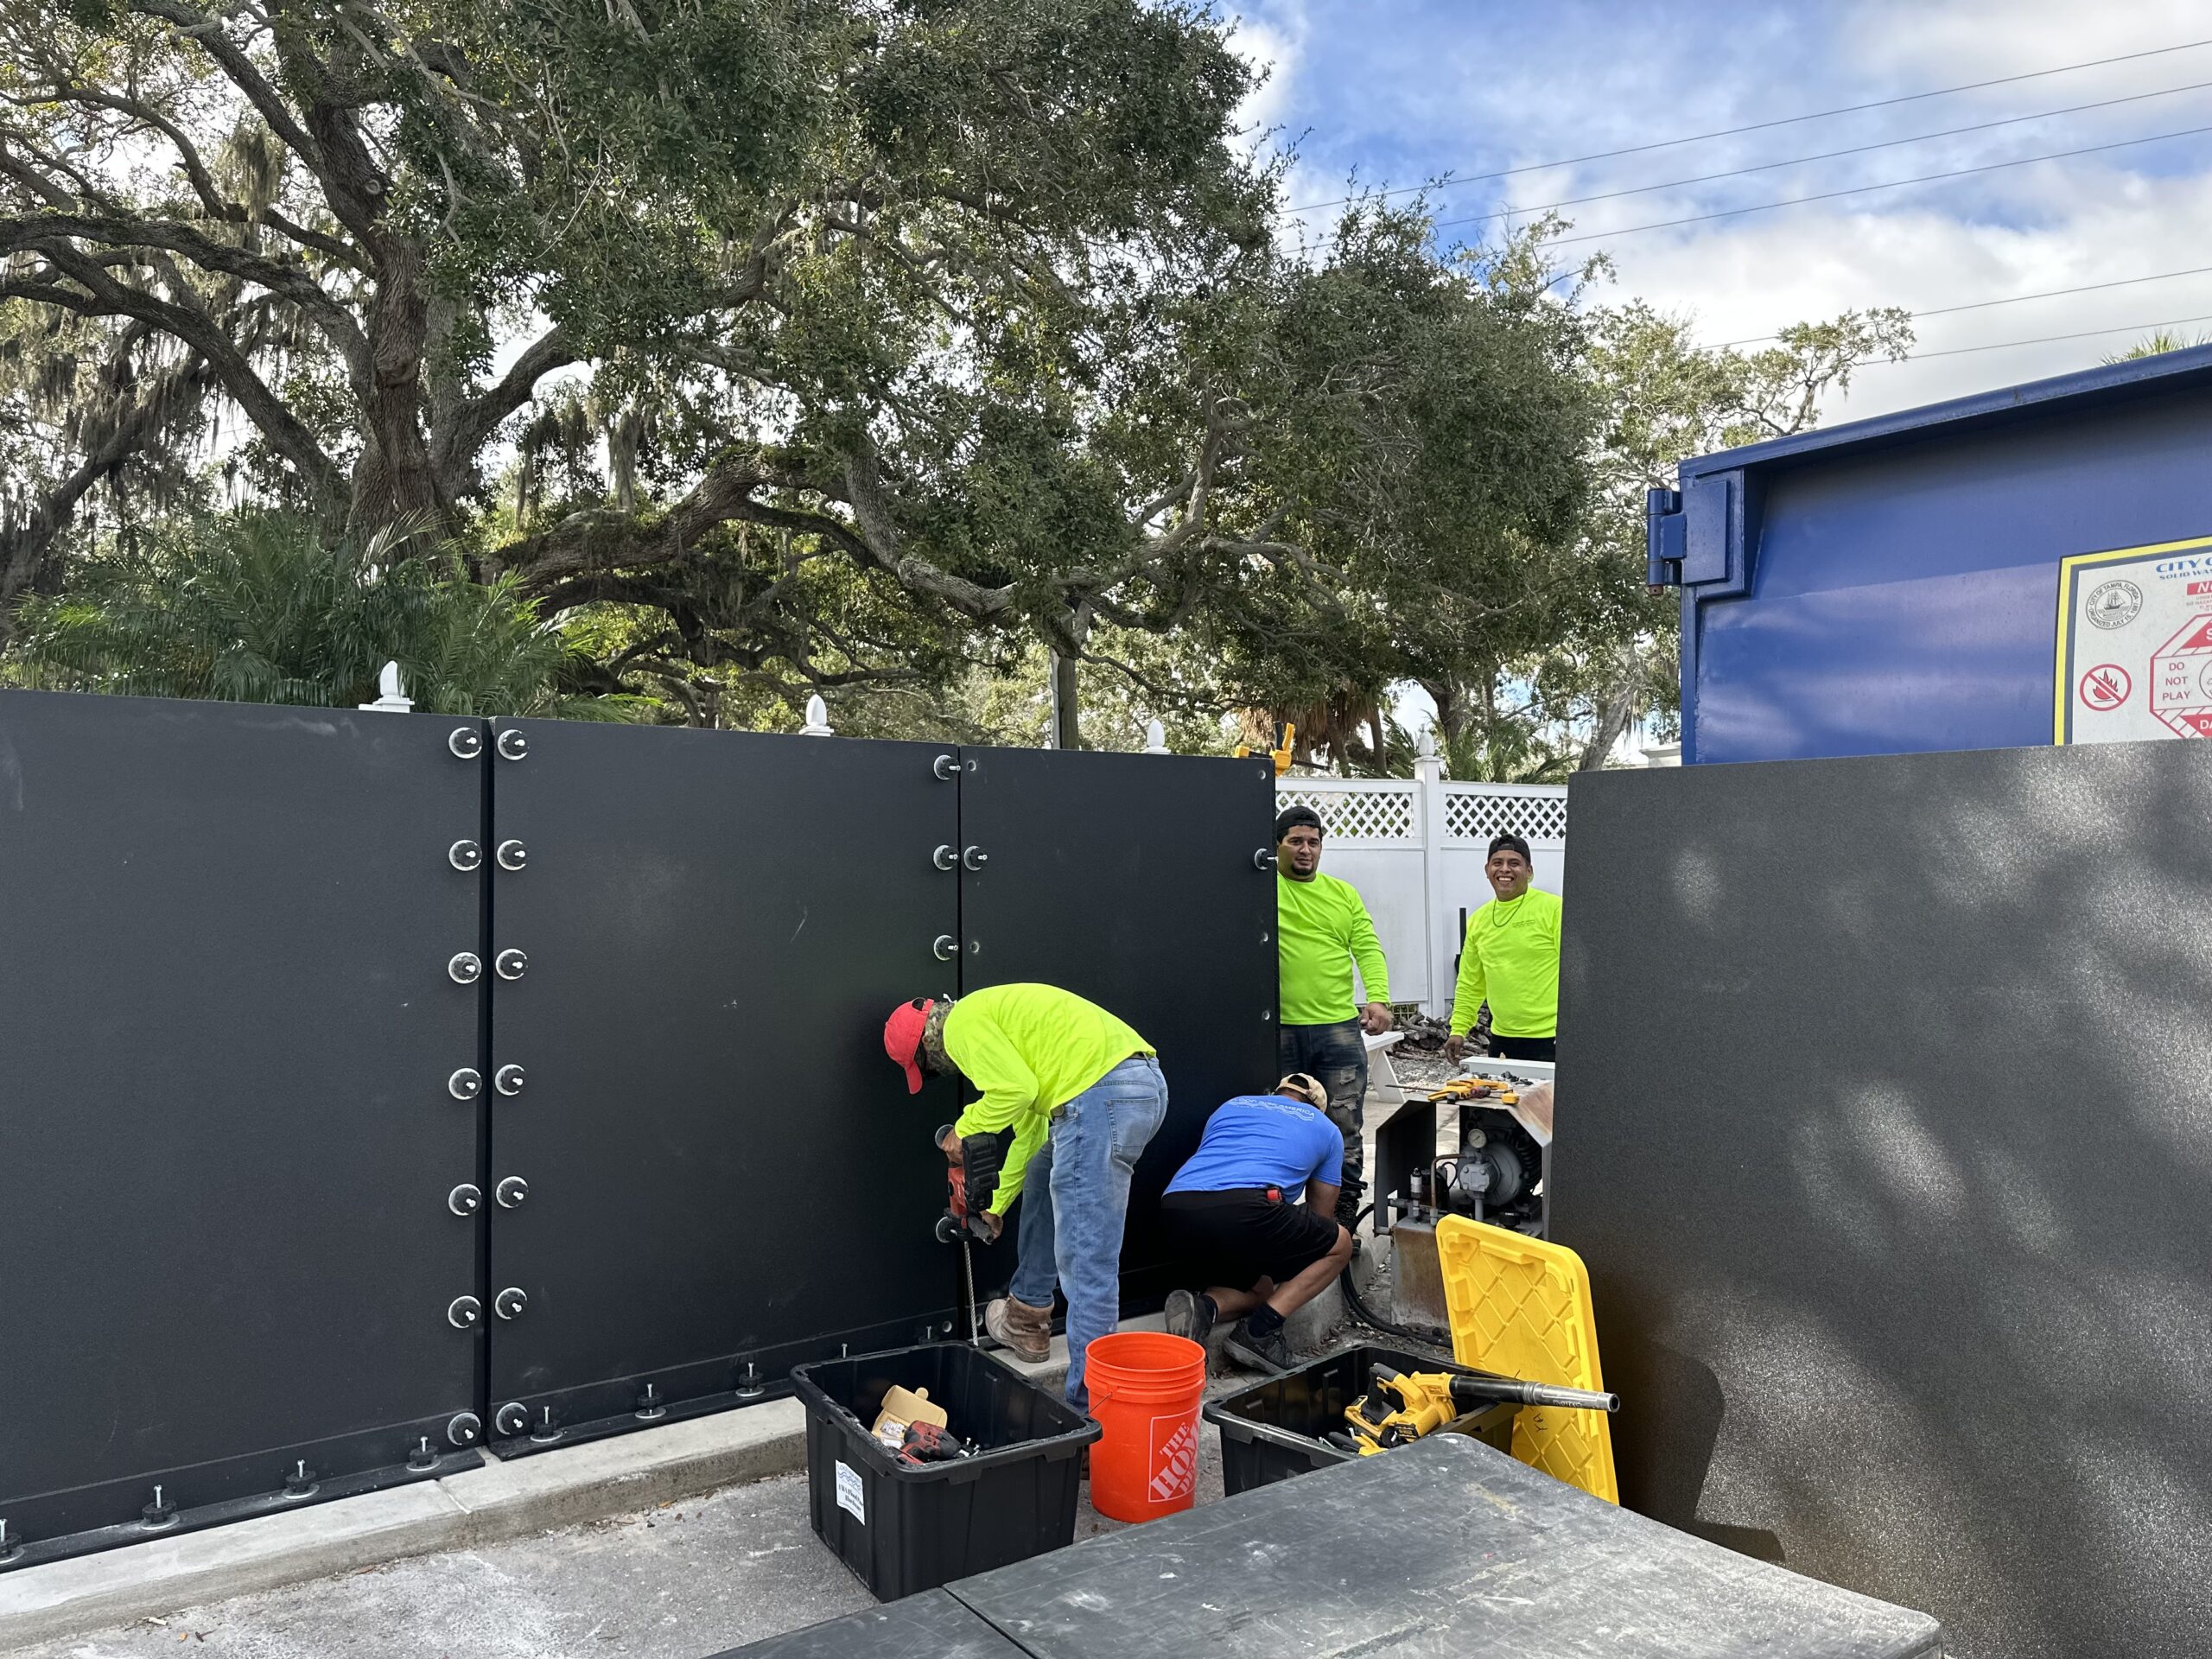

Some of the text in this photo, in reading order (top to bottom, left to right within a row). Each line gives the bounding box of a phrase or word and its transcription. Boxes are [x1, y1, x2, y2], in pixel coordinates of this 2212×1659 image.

[2156, 558, 2201, 573] CITY
[2124, 583, 2139, 600] FLORIDA
[2196, 582, 2212, 593] N
[2088, 608, 2111, 627] ORGANIZED
[2111, 619, 2125, 627] JULY
[2169, 661, 2184, 671] DO
[2165, 677, 2188, 686] NOT
[2162, 691, 2190, 701] PLAY
[2200, 719, 2212, 729] D
[1279, 1104, 1315, 1117] AMERICA
[1159, 1421, 1190, 1459] THE
[1151, 1408, 1199, 1499] HOM
